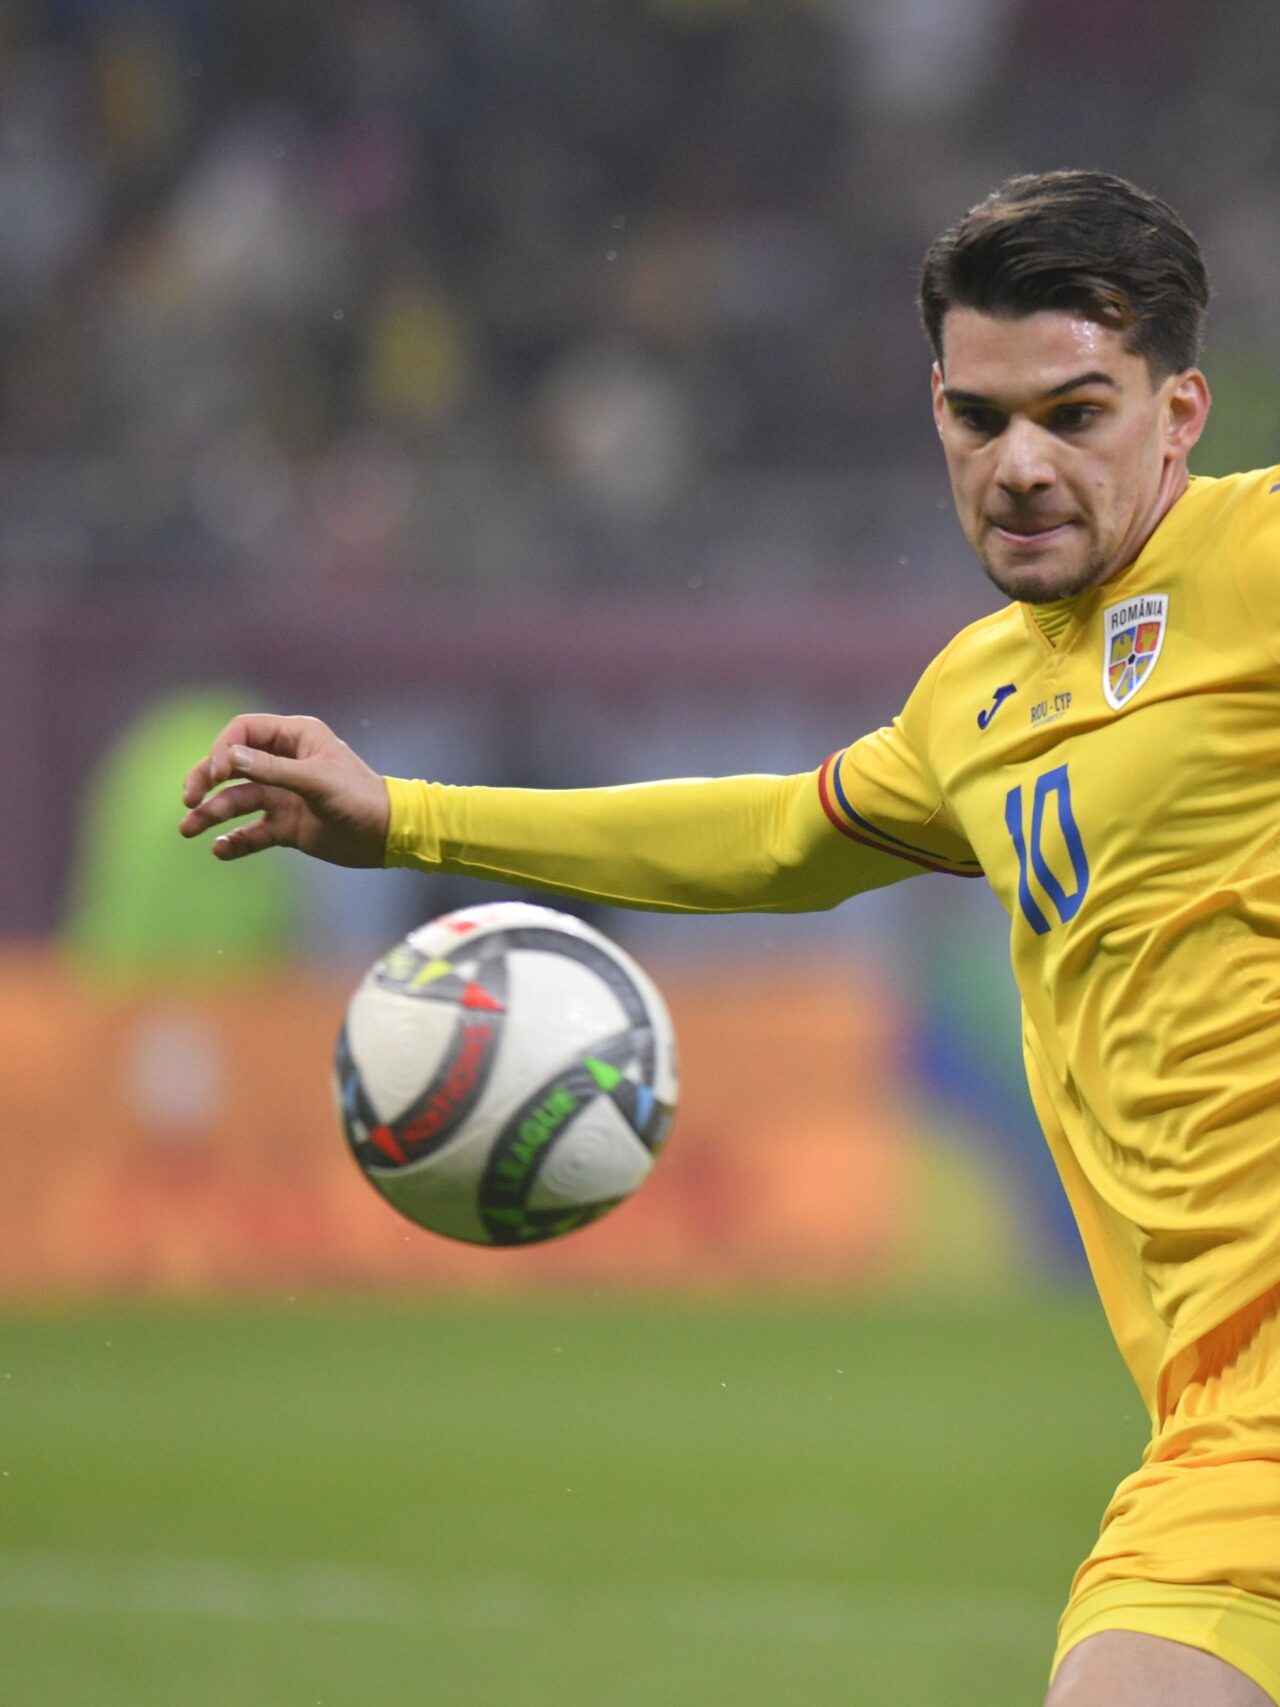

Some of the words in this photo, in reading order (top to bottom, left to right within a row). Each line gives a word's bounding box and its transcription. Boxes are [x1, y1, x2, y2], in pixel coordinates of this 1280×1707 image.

[1031, 700, 1048, 723] ROU
[1055, 692, 1072, 711] CYP
[1005, 763, 1090, 936] 10
